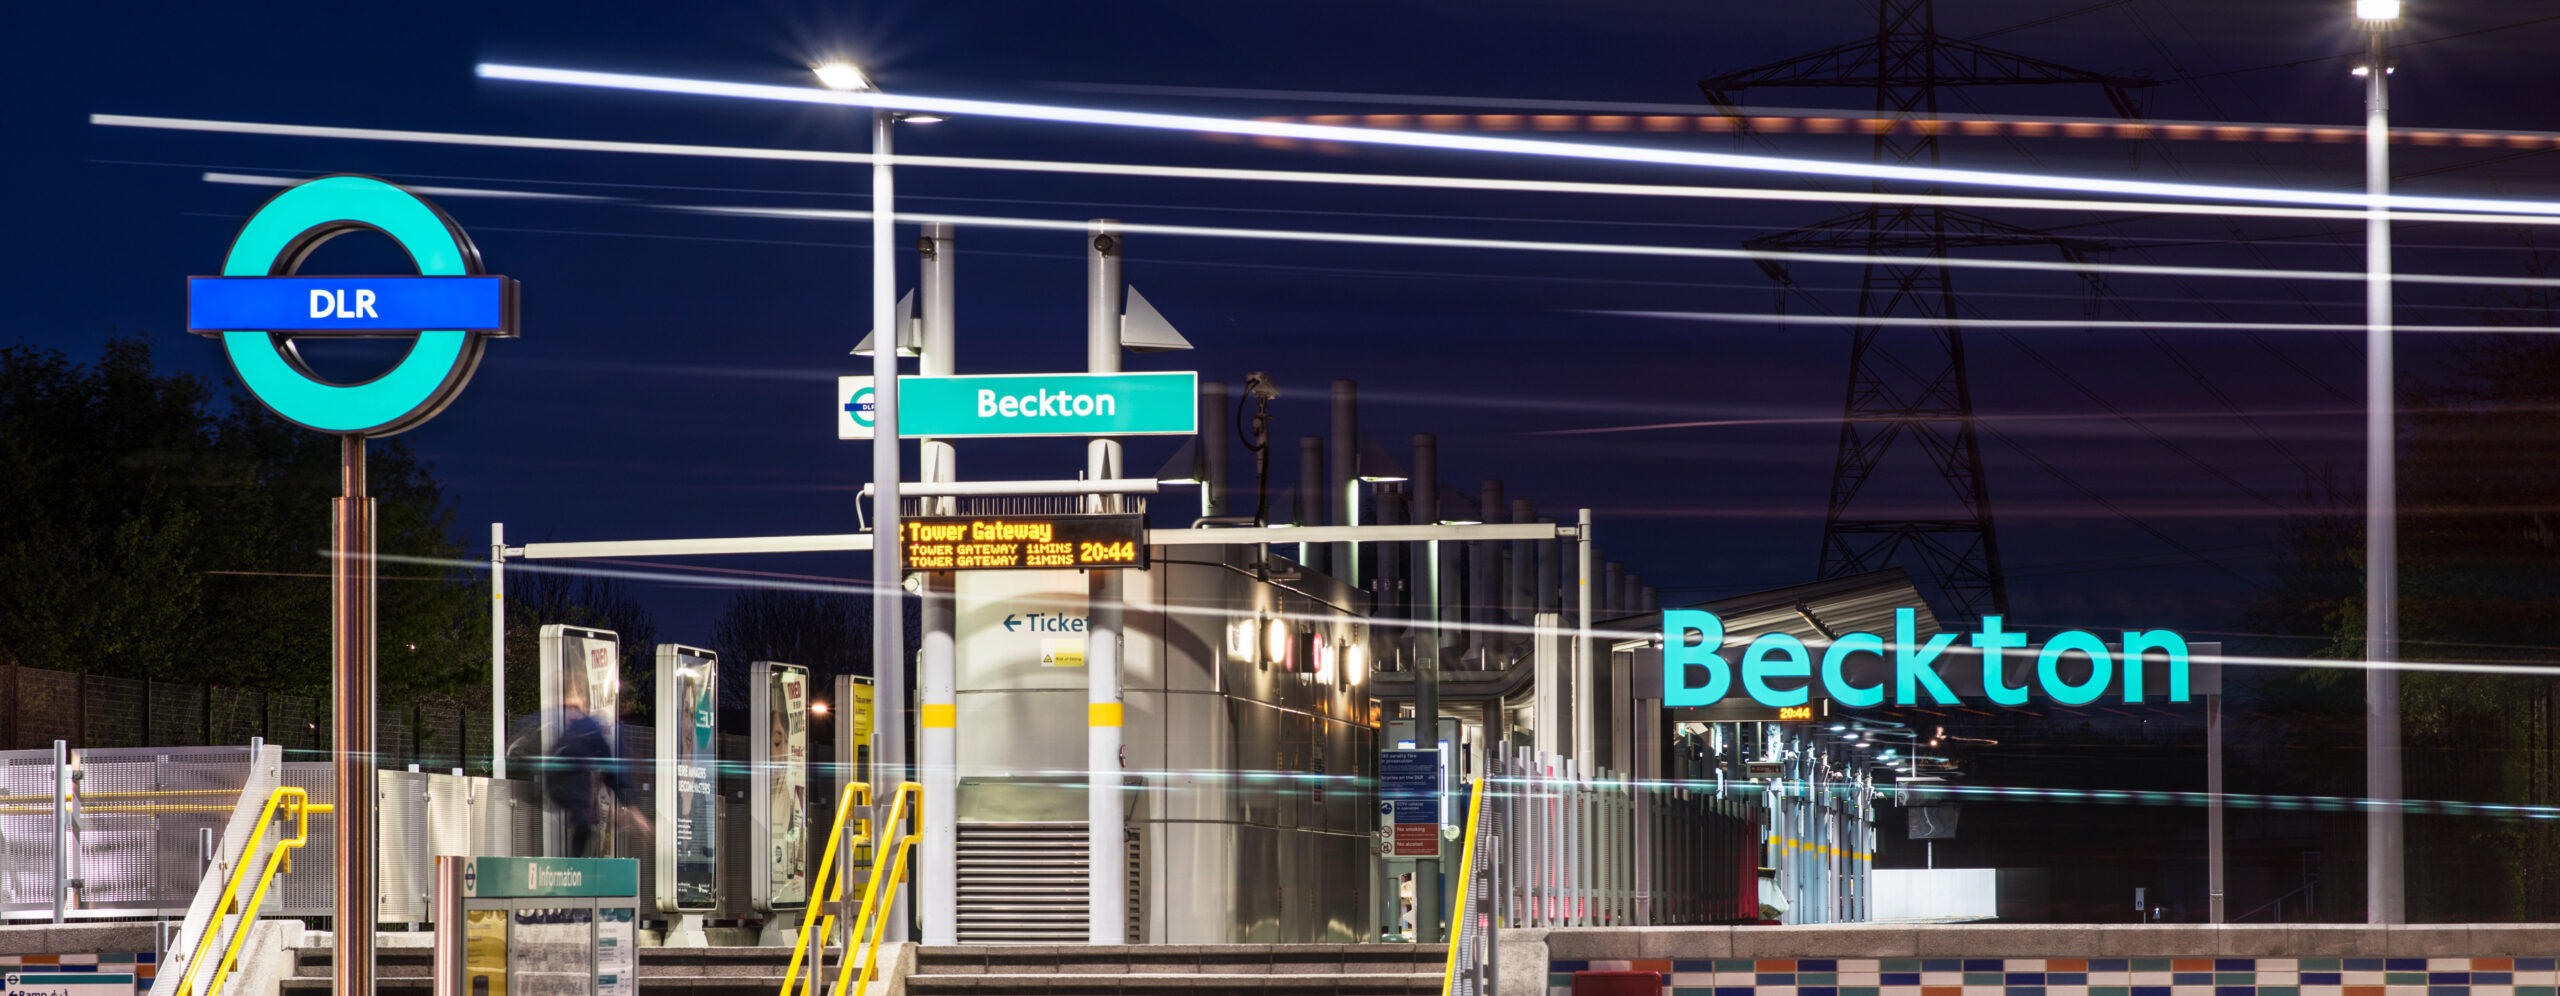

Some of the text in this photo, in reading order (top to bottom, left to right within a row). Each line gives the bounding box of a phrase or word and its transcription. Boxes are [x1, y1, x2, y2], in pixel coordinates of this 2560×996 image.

[309, 289, 379, 319] DLR
[977, 388, 1116, 418] Beckton
[909, 522, 968, 541] Tower
[972, 521, 1053, 543] Gateway
[909, 543, 1073, 556] TOWER GATEWAY 11MINS
[909, 554, 1075, 567] TOWER GATEWAY 21MINS
[1080, 542, 1135, 562] 20:44
[1662, 607, 2190, 708] Beckton
[1780, 707, 1811, 719] 20:44
[538, 866, 583, 888] Information
